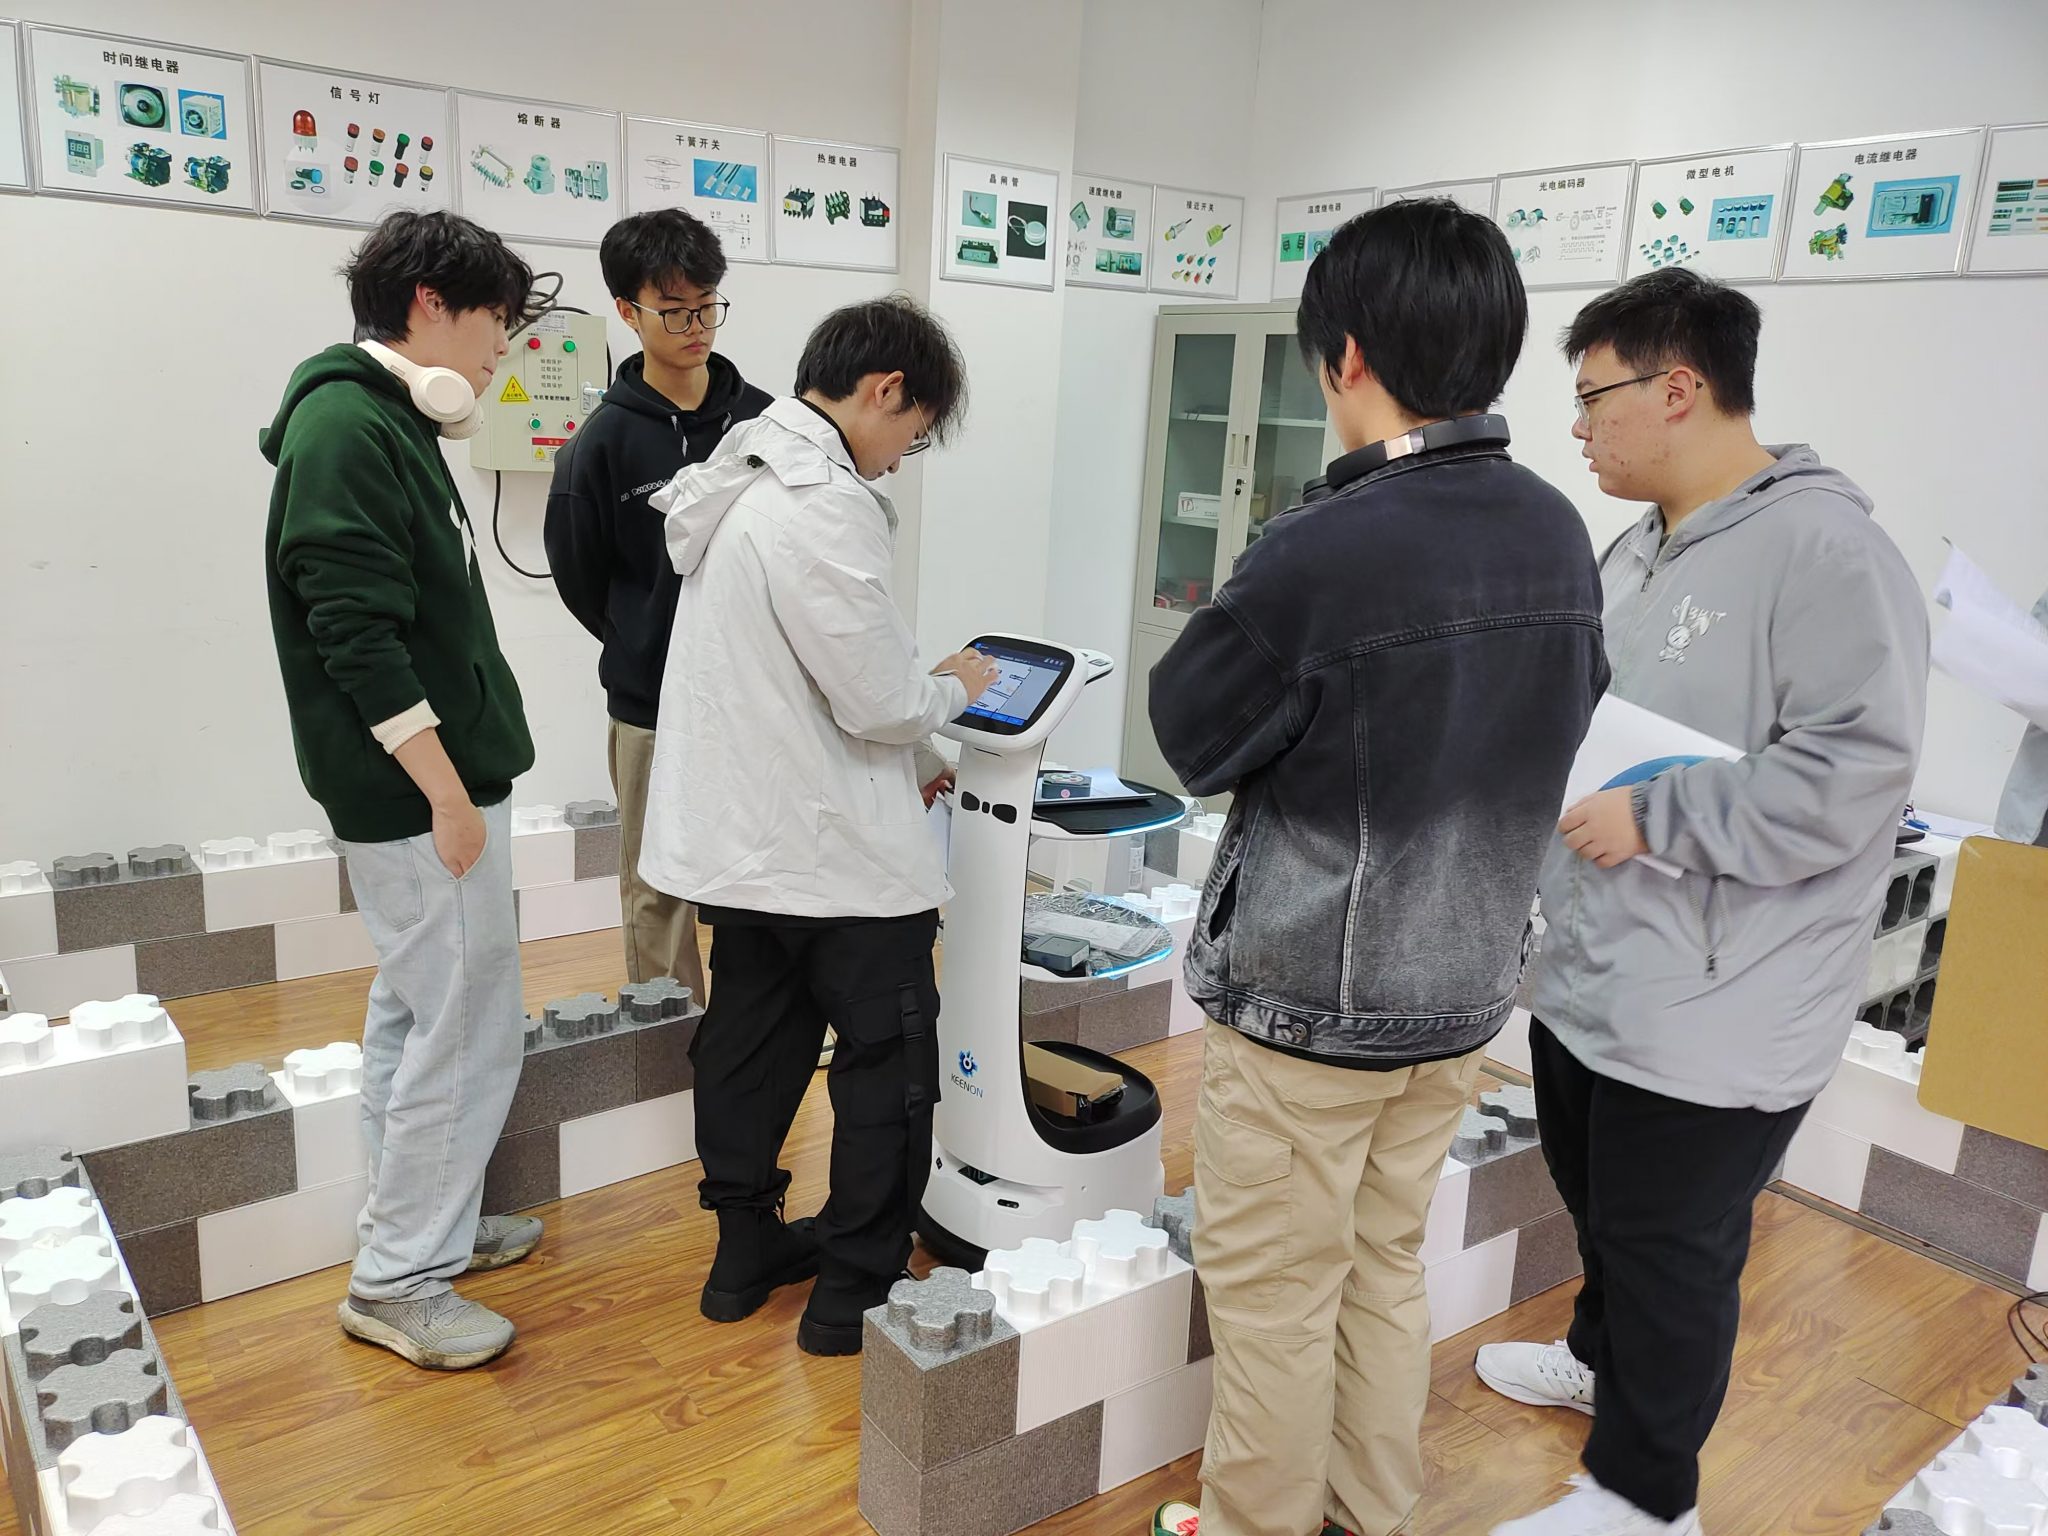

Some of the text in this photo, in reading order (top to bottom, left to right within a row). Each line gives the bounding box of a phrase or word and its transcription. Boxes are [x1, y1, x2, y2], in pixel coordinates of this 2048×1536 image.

[103, 51, 180, 74] 时间继电器
[330, 86, 381, 104] 信号灯
[517, 112, 561, 129] 熔断器
[675, 134, 720, 150] 干簧开关
[817, 153, 857, 168] 热继电器
[1854, 148, 1918, 165] 电流继电器
[989, 173, 1019, 187] 晶闸管
[1686, 165, 1735, 180] 微型电机
[1539, 178, 1585, 191] 光电编码器
[1088, 186, 1122, 199] 速度继电器
[1186, 200, 1214, 212] 接近开关
[1307, 202, 1342, 213] 温度继电器
[951, 1073, 984, 1099] KEENON
